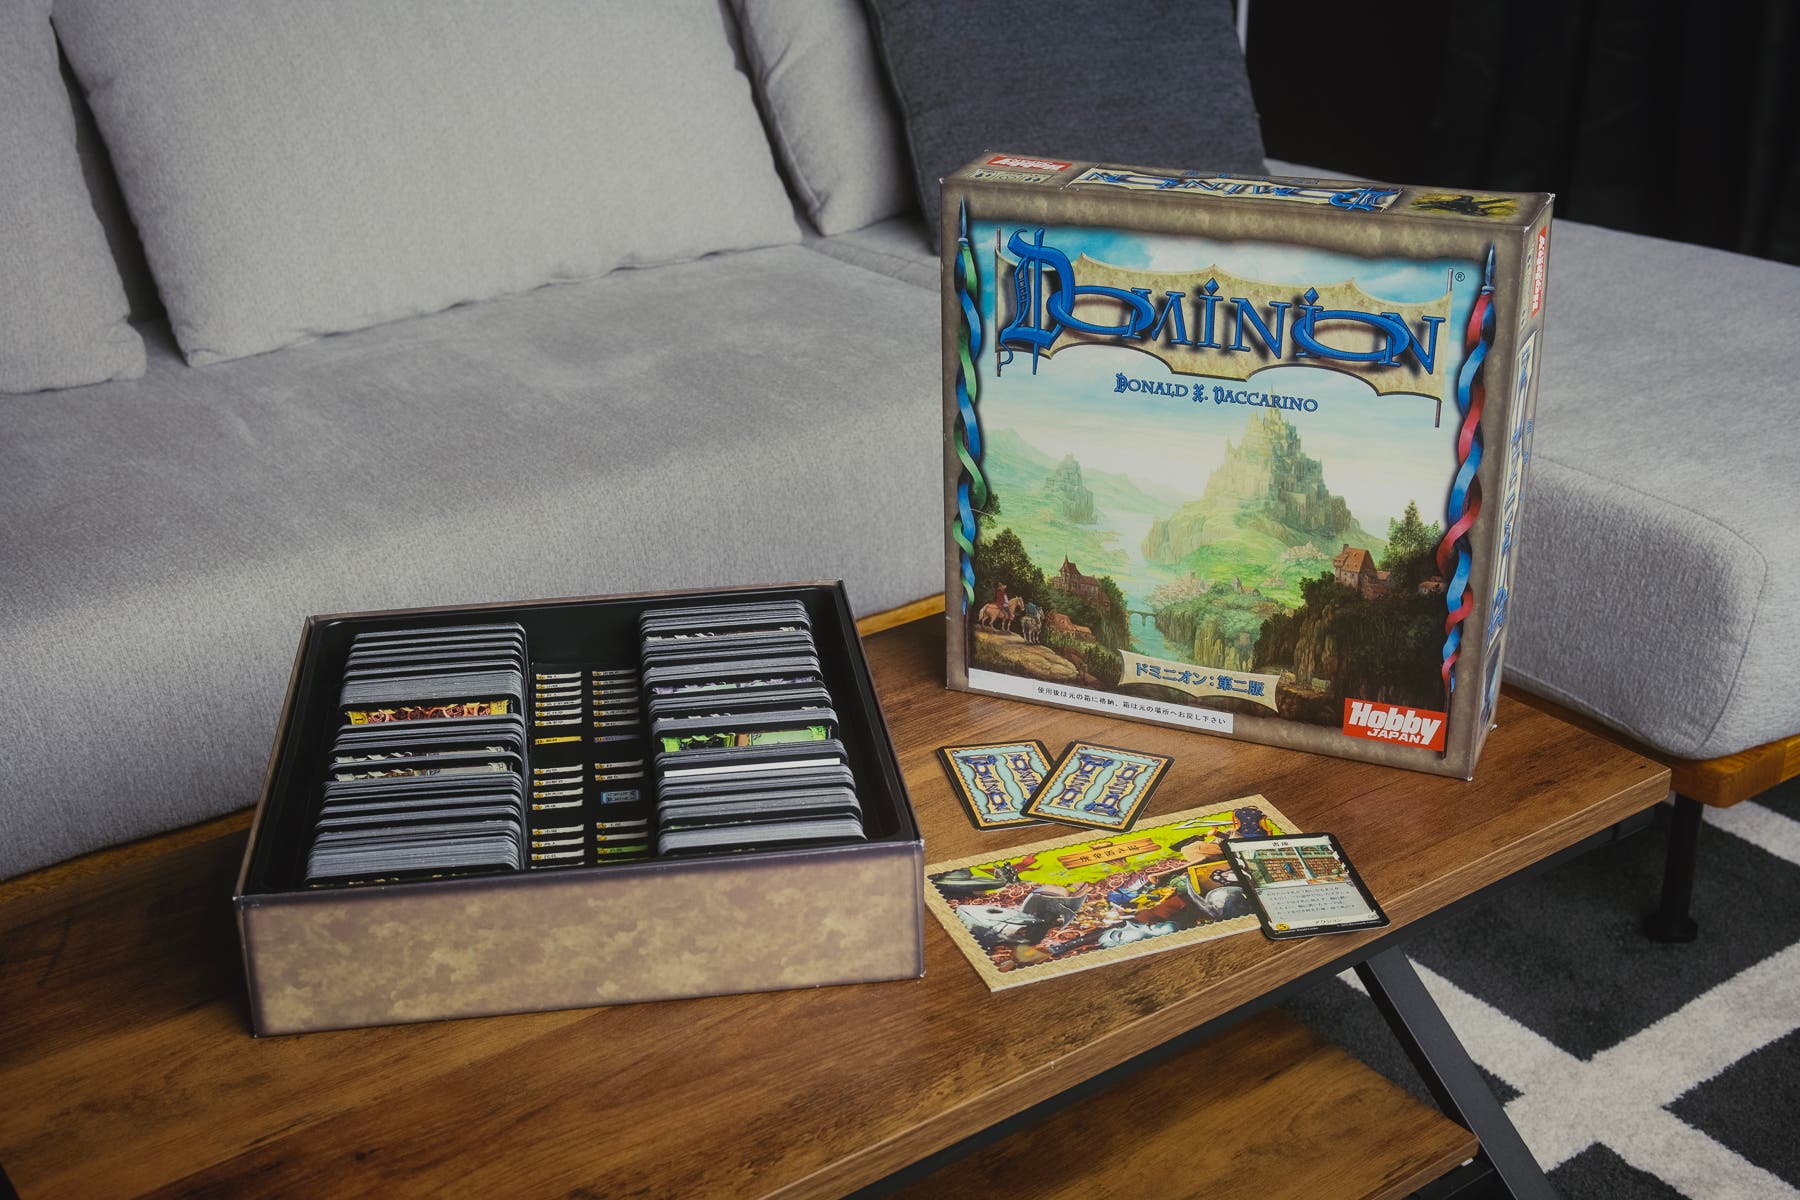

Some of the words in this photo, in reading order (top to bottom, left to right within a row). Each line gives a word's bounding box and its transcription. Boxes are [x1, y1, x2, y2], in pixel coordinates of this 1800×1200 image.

[1000, 227, 1446, 375] DOMINION
[1114, 372, 1188, 398] DONALD
[1213, 385, 1319, 413] VACCARINO
[1348, 701, 1442, 746] Hobby
[1367, 728, 1421, 744] JAPAN
